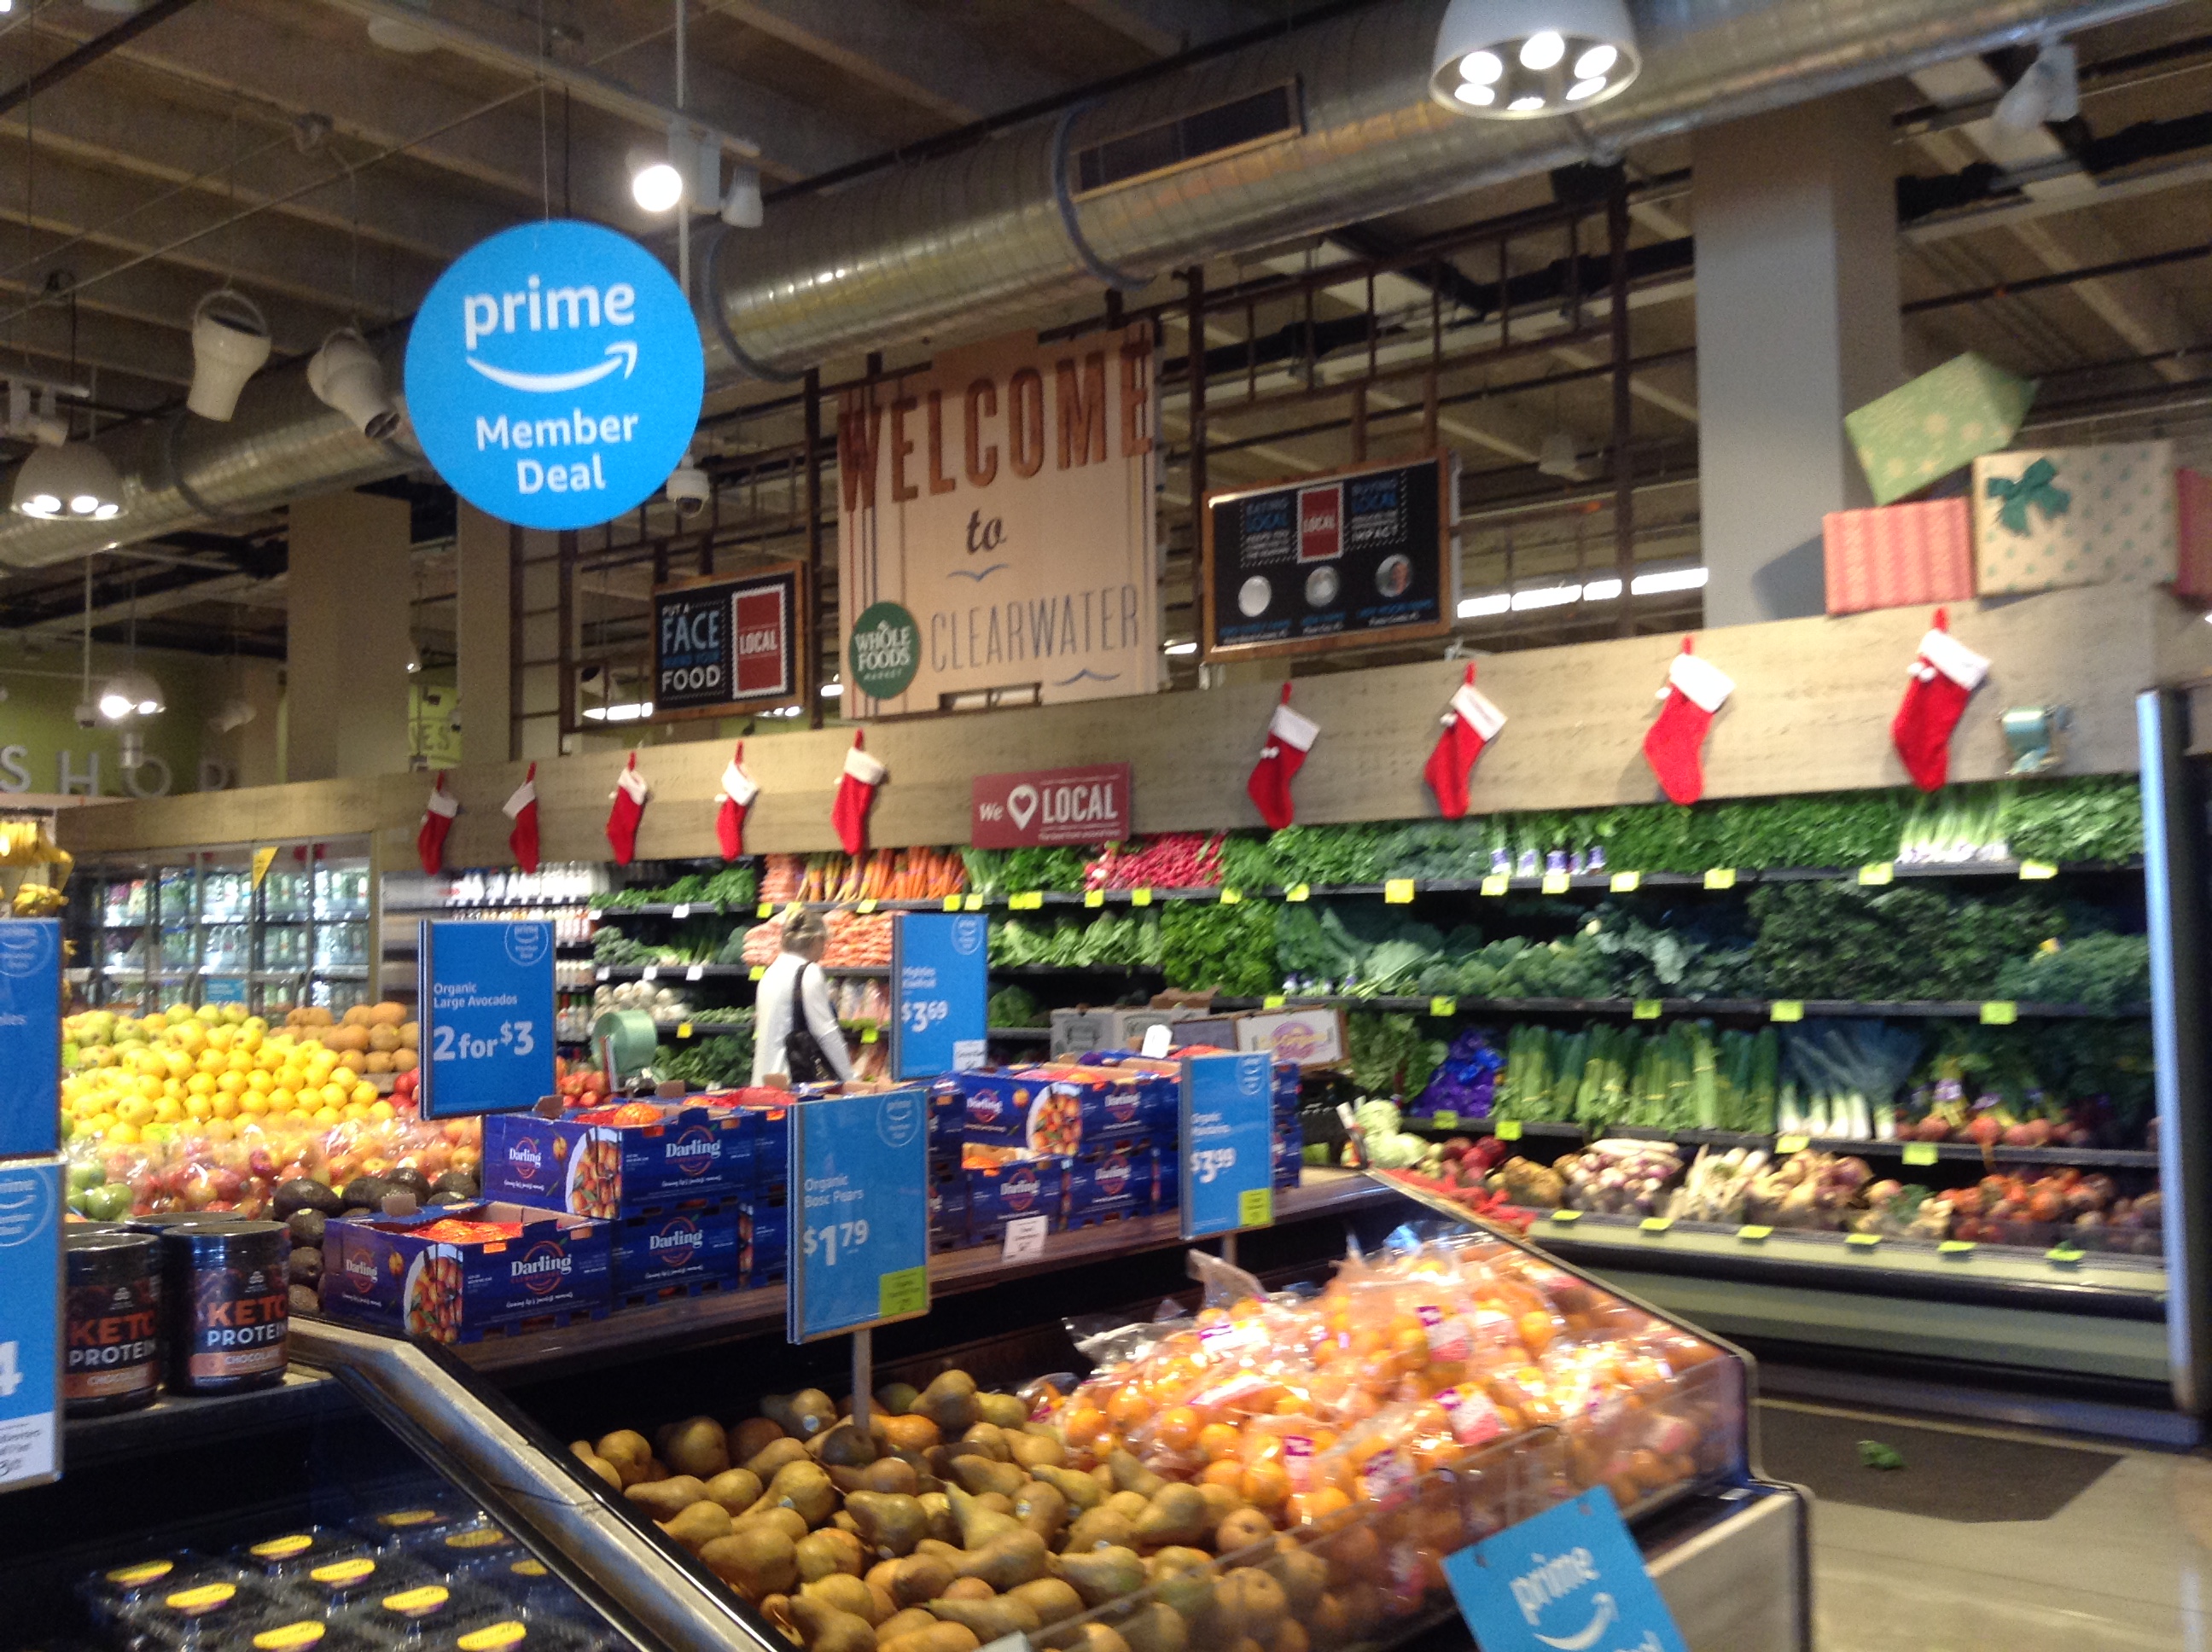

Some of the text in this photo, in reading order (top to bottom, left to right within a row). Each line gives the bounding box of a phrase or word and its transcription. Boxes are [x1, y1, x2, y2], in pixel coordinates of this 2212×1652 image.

[463, 274, 636, 351] prime
[475, 408, 639, 452] Member
[836, 341, 1154, 512] WELCOME
[516, 451, 607, 495] Deal
[965, 509, 1006, 555] to
[661, 610, 720, 655] FACE
[739, 630, 779, 655] LOCAL
[854, 620, 911, 653] WHOLE
[930, 585, 1139, 673] CLEARWATER
[858, 647, 911, 672] FOODS
[661, 665, 721, 693] FOOD
[980, 782, 1120, 824] We LOCAL
[434, 981, 477, 997] Organic
[434, 993, 518, 1010] Large Avocados
[433, 1020, 534, 1062] 2 for $3
[509, 1148, 542, 1168] Darling
[666, 1139, 721, 1159] Darling
[805, 1175, 849, 1192] Organic
[805, 1189, 864, 1208] Bosc Pears
[649, 1230, 704, 1248] Darling
[346, 1259, 378, 1283] Darling
[511, 1254, 572, 1277] Darling
[207, 1294, 287, 1327] KETO
[70, 1310, 156, 1346] KETO
[1510, 1546, 1599, 1626] prime
